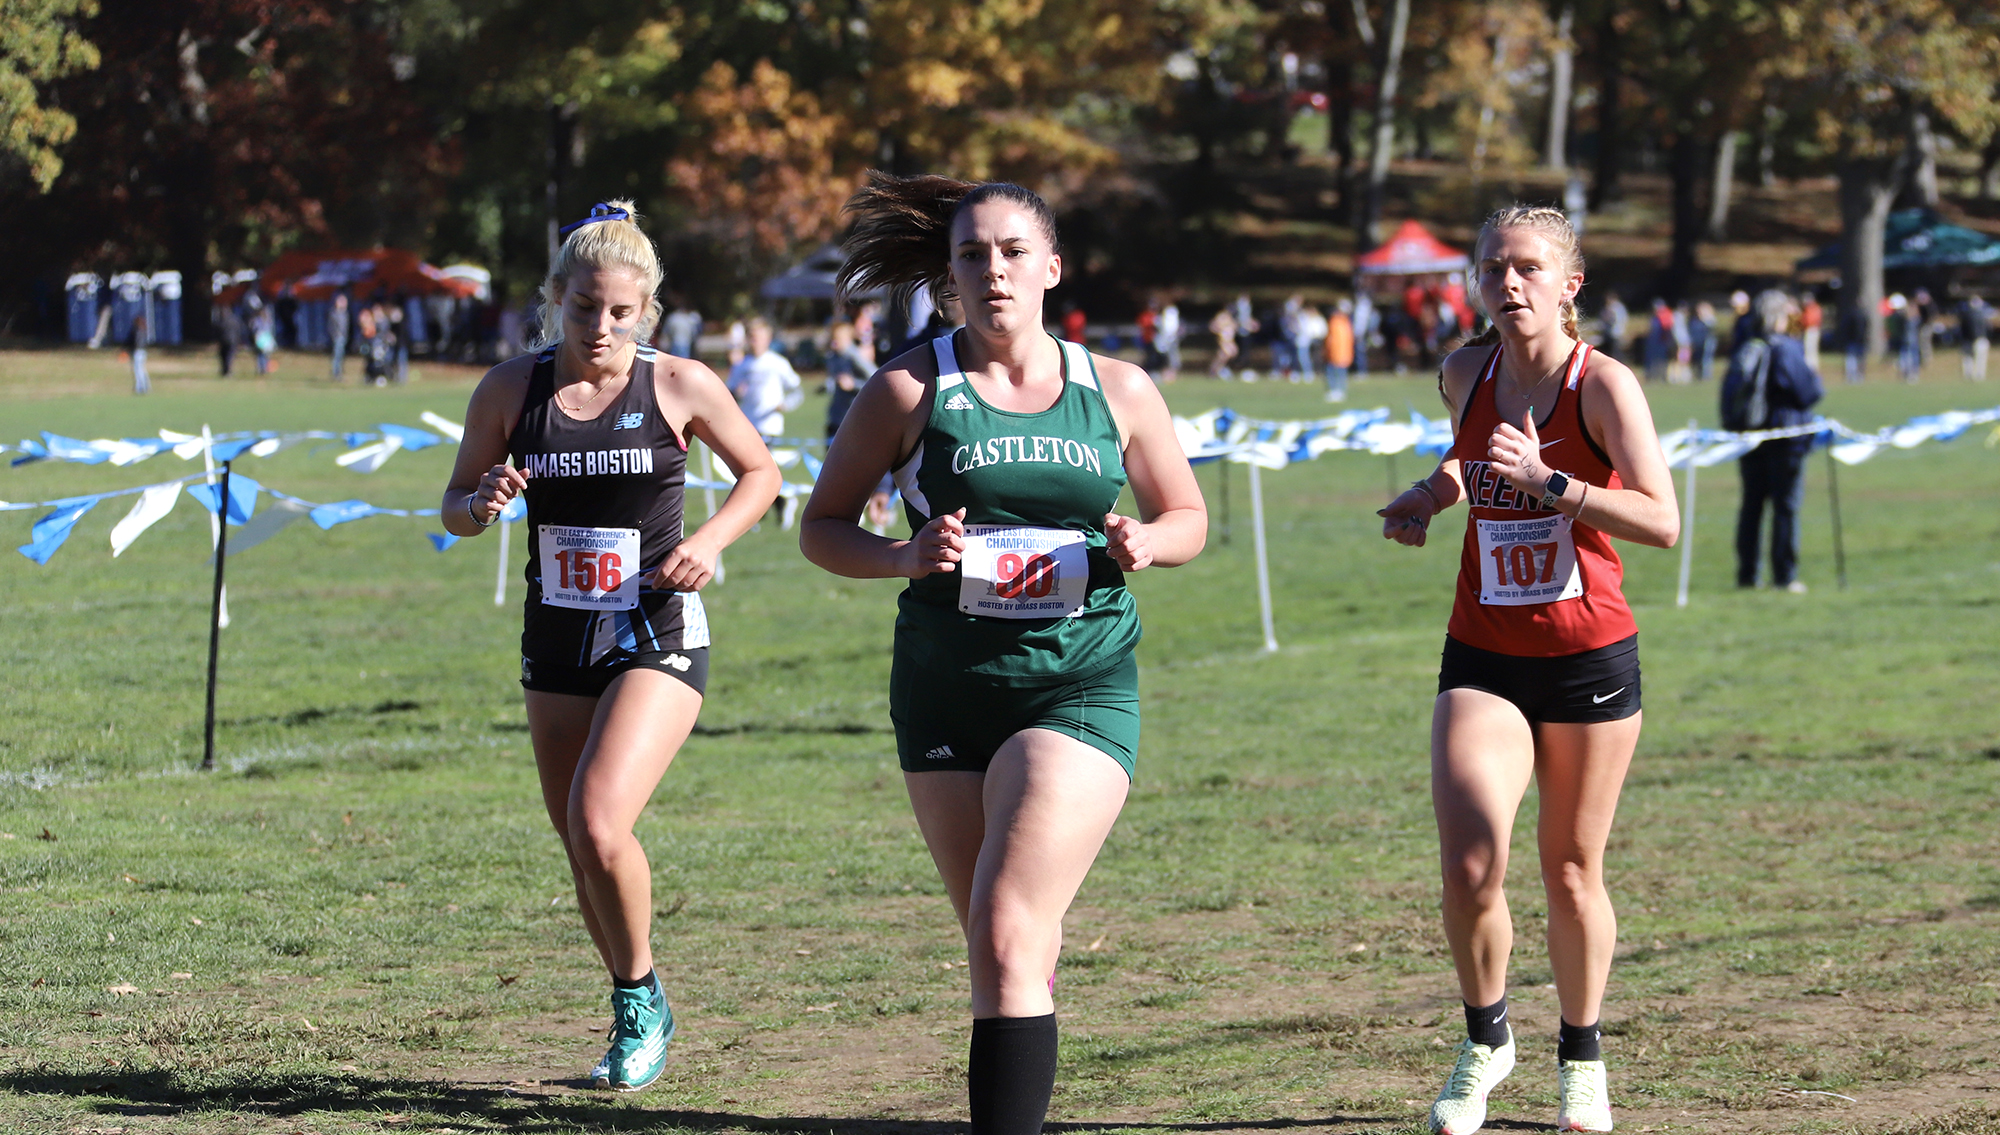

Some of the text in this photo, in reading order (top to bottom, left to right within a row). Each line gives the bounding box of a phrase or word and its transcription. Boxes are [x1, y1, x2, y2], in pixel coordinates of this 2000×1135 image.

[944, 402, 974, 410] adidas
[525, 448, 654, 479] UMASS BOSTON
[952, 436, 1102, 478] CASTLETON
[1463, 461, 1574, 513] KEE
[1484, 518, 1558, 531] LITTLE EAST CONFERENCE
[549, 527, 626, 539] LITTLE EAST CONFERENCE
[976, 528, 1001, 537] LITTLE
[1003, 528, 1022, 537] EAST
[1490, 528, 1552, 543] CHAMPIONSHIP
[556, 536, 618, 549] CHAMPIONSHIP
[986, 537, 1061, 550] CHAMPIONSHIP
[1490, 541, 1559, 587] 107
[554, 550, 622, 593] 156
[996, 553, 1053, 599] 90
[554, 592, 622, 604] HOSTED BY UMASS BOSTON
[1494, 585, 1565, 598] HOSTED BY UMASS BOSTON
[977, 600, 1065, 611] HOSTED BY UMASS BOSTON
